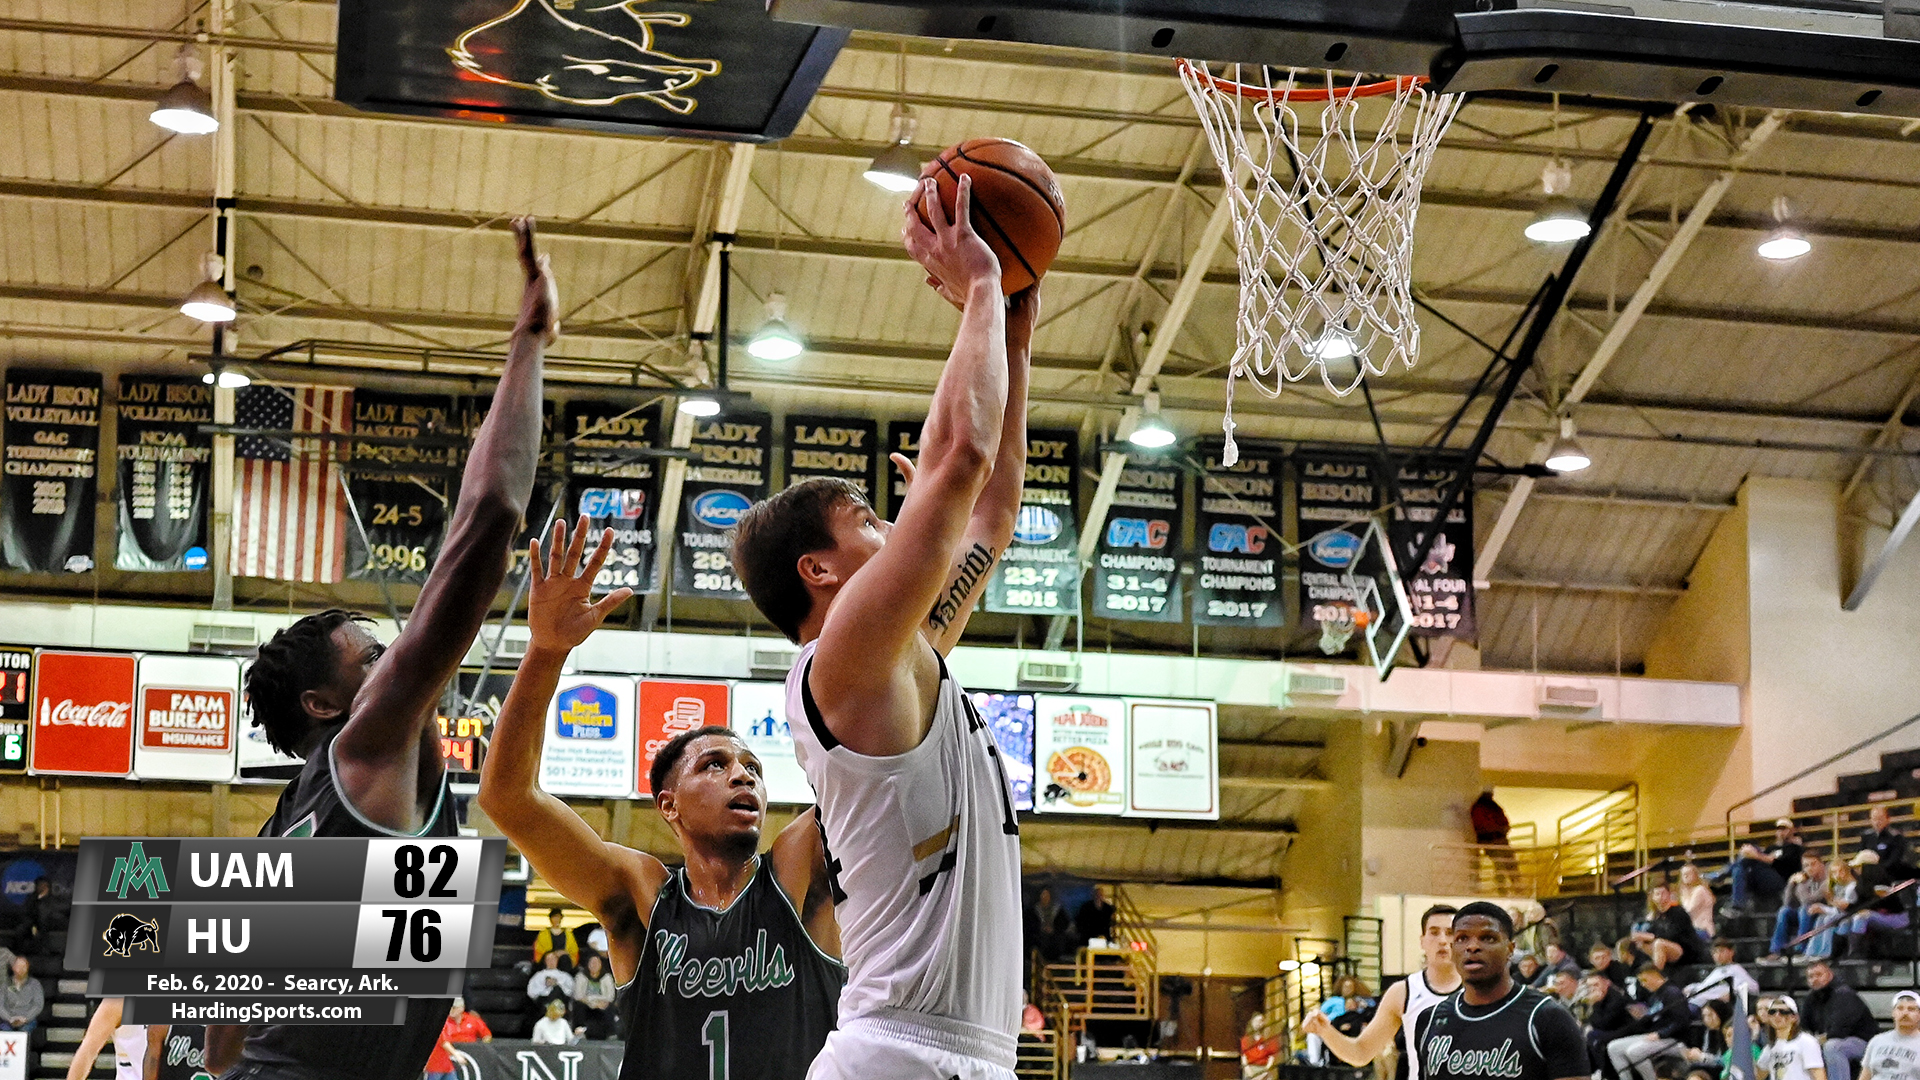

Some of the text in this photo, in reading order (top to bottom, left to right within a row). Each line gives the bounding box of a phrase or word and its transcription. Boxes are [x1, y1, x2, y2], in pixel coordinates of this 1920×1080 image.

[6, 383, 99, 407] LADY BISON
[118, 383, 161, 403] LADY
[6, 406, 99, 426] VOLLEYBALL
[119, 404, 212, 423] VOLLEYBALL
[576, 415, 649, 437] LADY
[692, 421, 762, 443] LADY
[33, 430, 70, 446] GAC
[139, 431, 188, 446] NCAA
[794, 425, 867, 448] LADY
[791, 449, 869, 473] BISON
[372, 502, 423, 526] 24-5
[1106, 517, 1171, 549] GAC
[1208, 523, 1269, 554] GAC
[1100, 553, 1176, 573] CHAMPIONS
[1201, 556, 1276, 574] TOURNAMENT
[593, 568, 640, 586] 014
[1004, 566, 1059, 587] 23-7
[1200, 574, 1277, 592] CHAMPIONS
[1006, 589, 1059, 608] 2015
[1106, 594, 1167, 613] 2017
[1207, 600, 1268, 618] 2017
[170, 692, 226, 714] FARM
[572, 700, 600, 714] Best
[149, 709, 226, 731] BUREAU
[561, 710, 613, 727] Western
[4, 734, 22, 761] 6
[161, 731, 226, 747] INSURANCE
[546, 765, 624, 779] 501-279-9191
[655, 928, 796, 1000] Weevils
[701, 1009, 730, 1080] 1
[1427, 1034, 1523, 1077] Weevils
